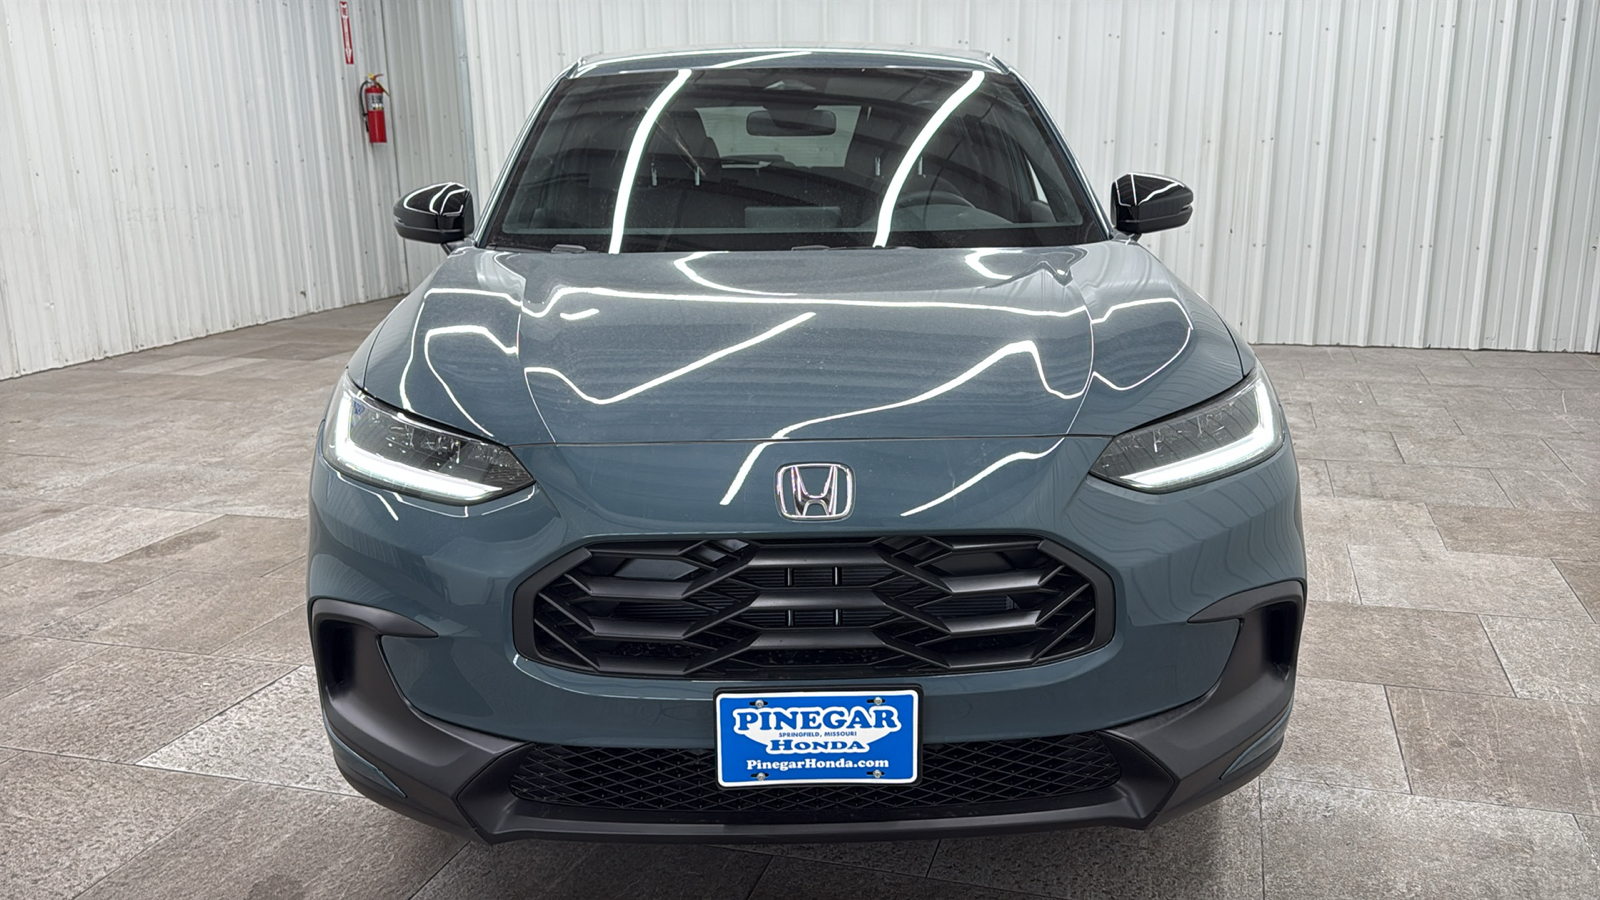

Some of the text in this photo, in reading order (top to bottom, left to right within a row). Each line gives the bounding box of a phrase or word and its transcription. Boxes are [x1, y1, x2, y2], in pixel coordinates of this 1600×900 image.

[737, 709, 898, 731] PINEGAR
[769, 739, 867, 751] HONDA
[746, 758, 889, 771] PinegarHonda.com
